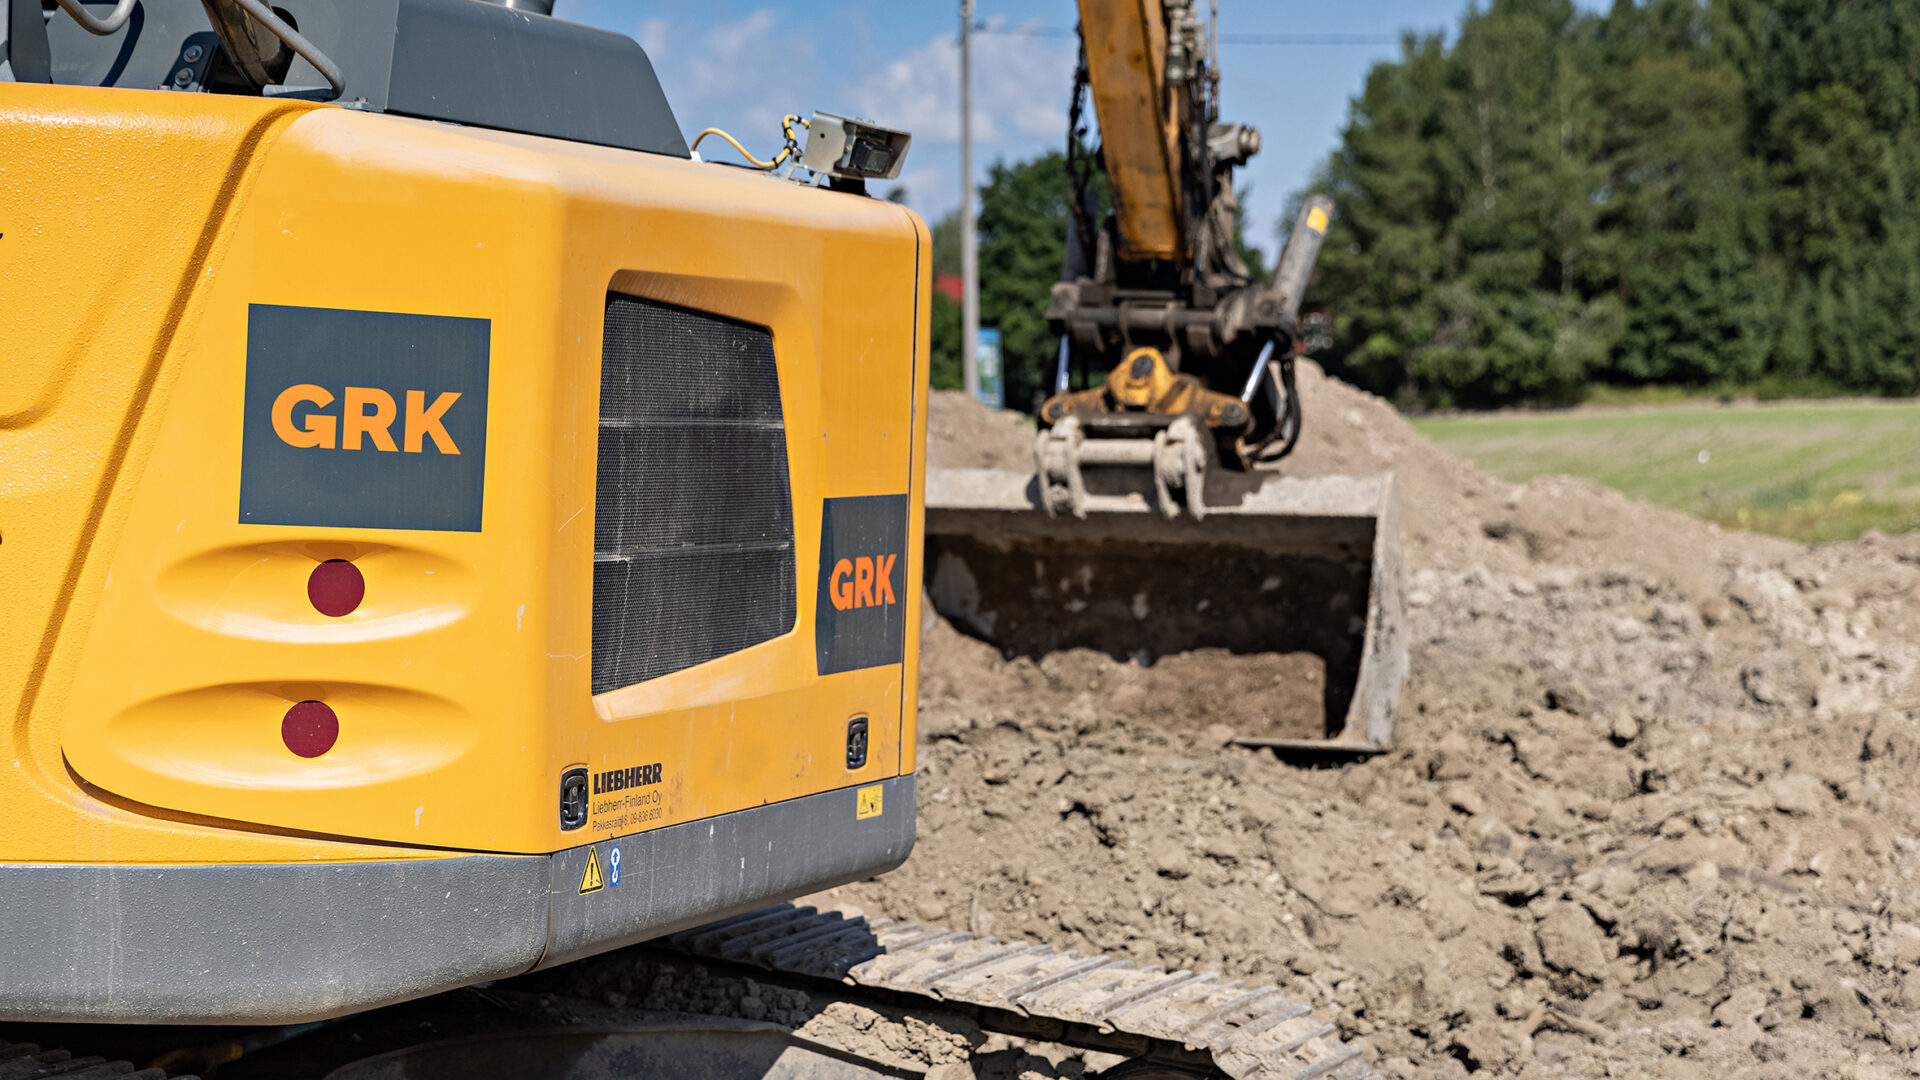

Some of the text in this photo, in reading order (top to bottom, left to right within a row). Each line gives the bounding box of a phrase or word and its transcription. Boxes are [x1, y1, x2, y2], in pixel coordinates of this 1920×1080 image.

[271, 383, 462, 456] GRK
[829, 553, 898, 611] GRK
[593, 762, 662, 795] LIEBHERR
[592, 789, 662, 815] Liebherr-Finland Oy
